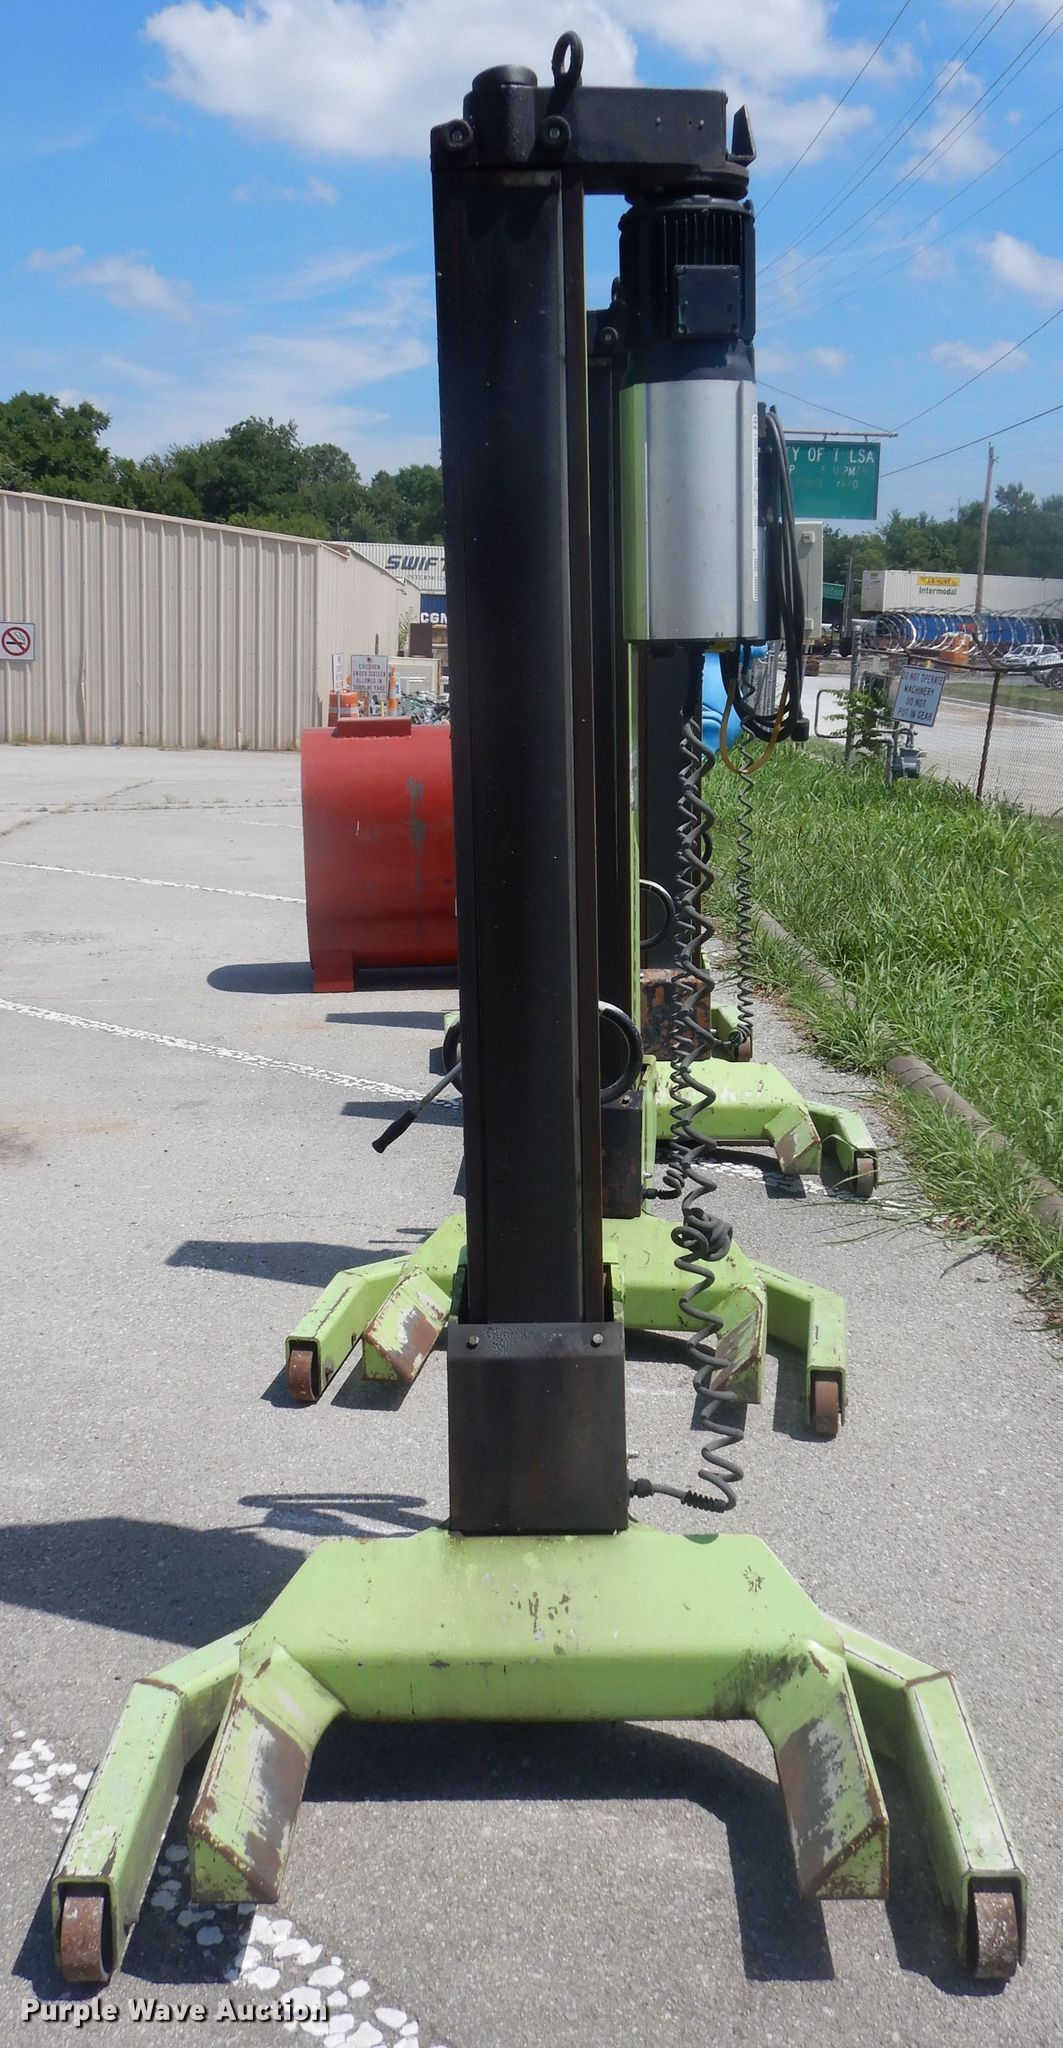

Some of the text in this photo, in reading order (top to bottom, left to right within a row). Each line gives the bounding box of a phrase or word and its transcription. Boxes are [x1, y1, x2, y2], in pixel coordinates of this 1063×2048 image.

[808, 447, 824, 462] OF
[919, 587, 957, 595] Intermodal
[910, 672, 920, 681] NOT
[920, 673, 944, 685] OPERATE
[904, 685, 935, 696] MACHINERY
[906, 697, 927, 708] DO NOT
[898, 707, 933, 721] PUT IN GEAR
